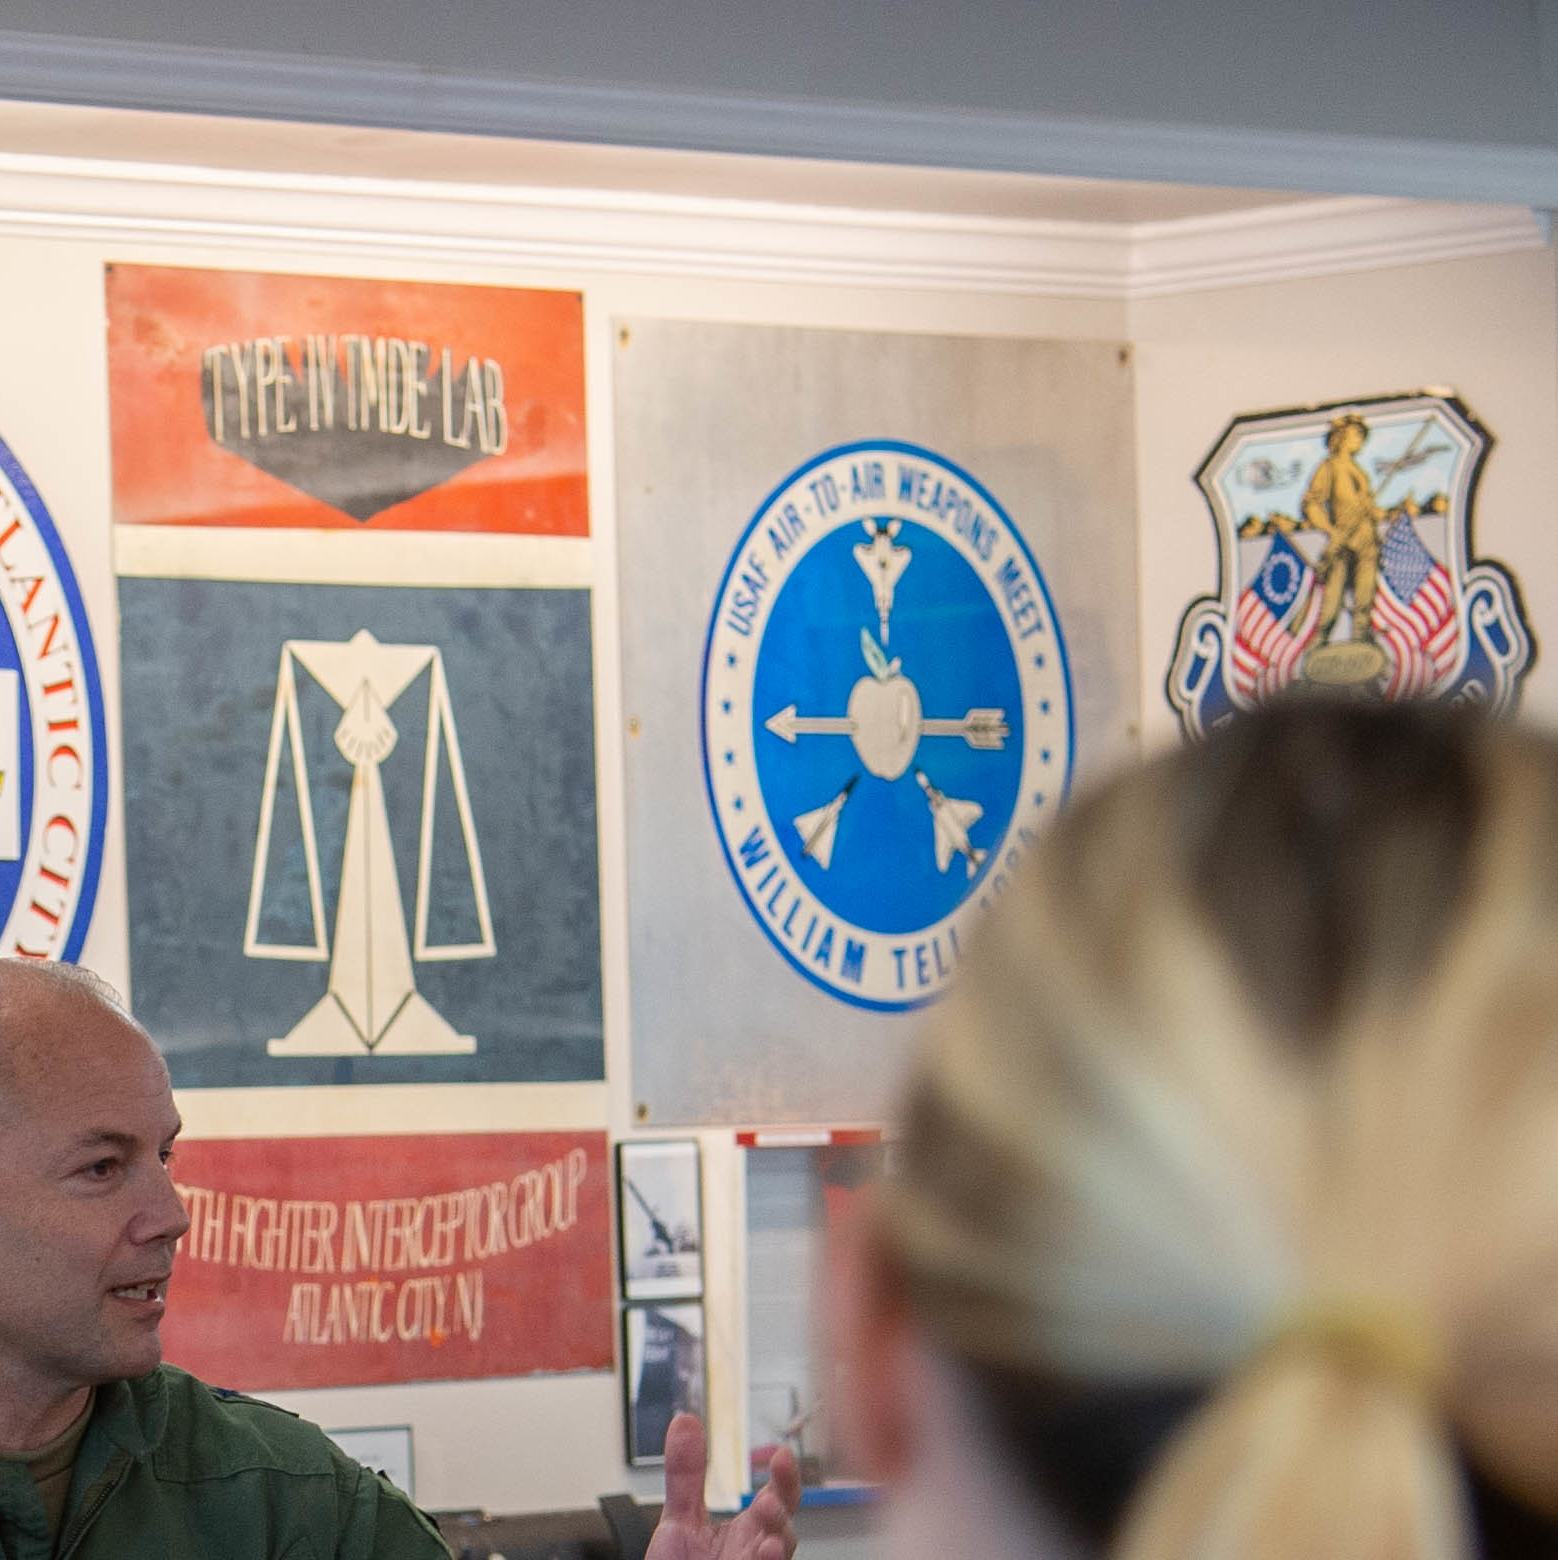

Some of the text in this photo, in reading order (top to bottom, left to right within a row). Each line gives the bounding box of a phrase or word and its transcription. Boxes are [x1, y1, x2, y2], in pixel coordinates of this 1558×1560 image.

[204, 333, 509, 456] TYPE IV TMDE LAB
[726, 552, 771, 637] USAF
[897, 463, 1001, 563] WEAPONS
[996, 557, 1045, 640] MEET
[738, 826, 867, 985] WILLIAM
[228, 1194, 340, 1274] FIGHTER
[341, 1183, 509, 1274] INTERCEPTOR
[508, 1147, 589, 1250] GROUP
[282, 1280, 396, 1346] ATLANTIC
[453, 1268, 484, 1342] NJ
